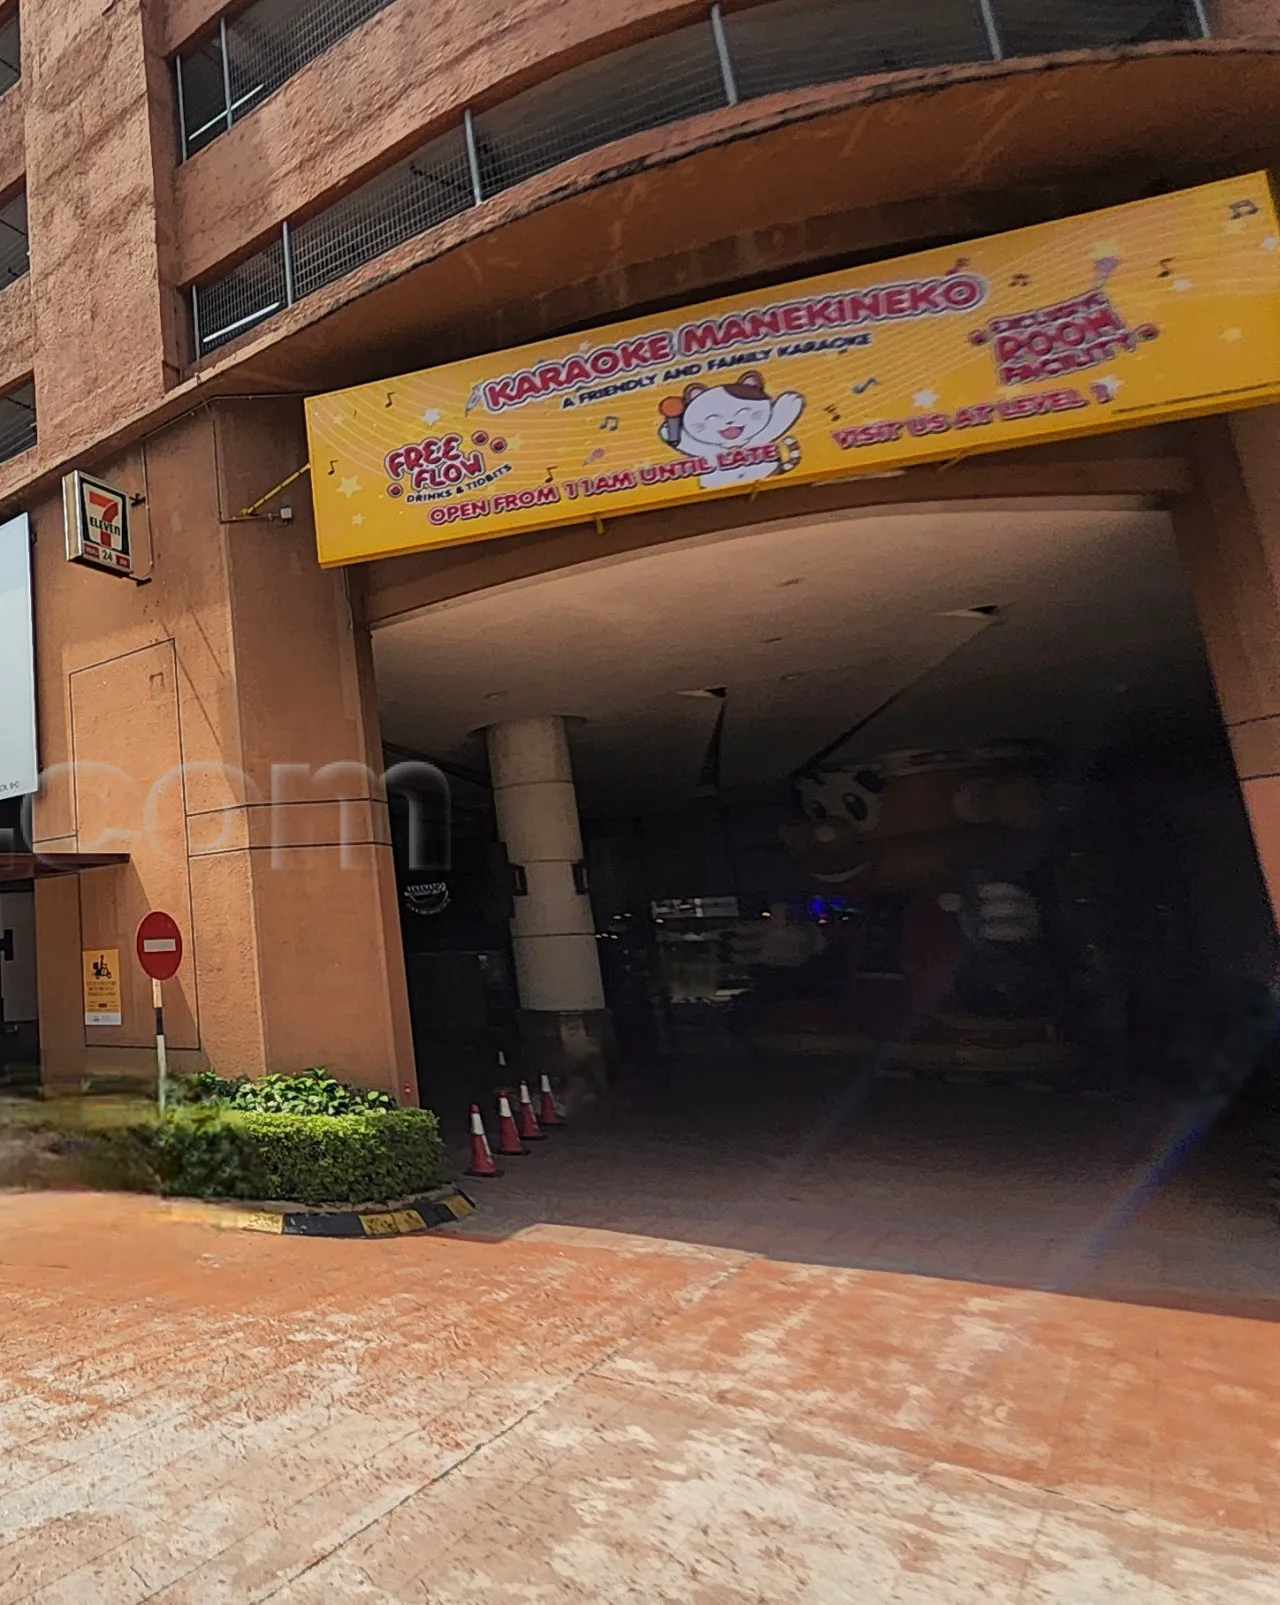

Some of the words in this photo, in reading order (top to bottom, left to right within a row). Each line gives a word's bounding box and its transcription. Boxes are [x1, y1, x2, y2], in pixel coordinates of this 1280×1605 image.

[485, 333, 674, 411] KARAOKE
[682, 277, 983, 355] MANEKINEKO
[562, 397, 576, 409] A
[579, 374, 657, 404] FRIENDLY
[662, 364, 702, 381] AND
[707, 349, 772, 371] FAMILY
[777, 333, 872, 357] KARAOKE
[832, 422, 901, 447] VISIT
[907, 413, 949, 435] US
[953, 405, 993, 428] AT
[999, 390, 1086, 419] LEVEL
[1091, 384, 1110, 403] 1
[387, 433, 462, 479] FREE
[406, 489, 452, 503] DRINKS
[456, 486, 464, 495] &
[467, 464, 512, 490] TIDBITS
[413, 451, 484, 490] FLOW
[429, 502, 488, 524] OPEN
[493, 486, 559, 511] FROM
[564, 471, 634, 496] 11AM
[640, 456, 711, 483] UNTIL
[717, 444, 778, 468] LATE
[89, 490, 119, 548] 7
[102, 549, 113, 562] 24
